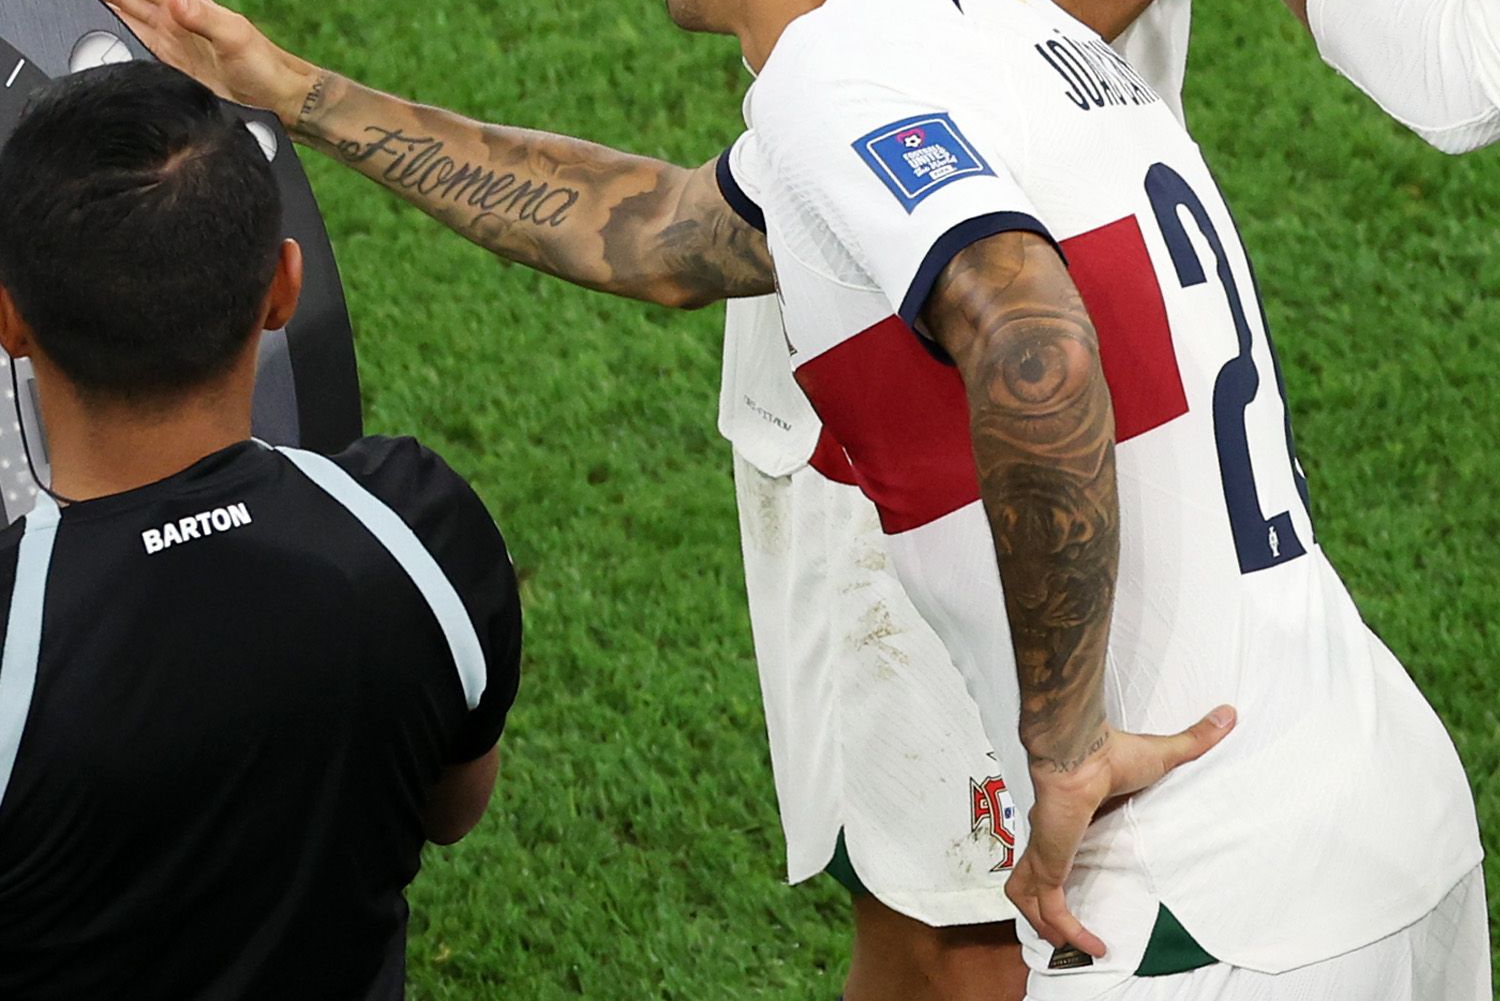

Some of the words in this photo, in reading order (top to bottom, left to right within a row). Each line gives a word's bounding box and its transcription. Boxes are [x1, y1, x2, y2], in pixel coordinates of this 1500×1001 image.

[336, 125, 579, 227] Filomena
[1144, 161, 1317, 575] 2
[141, 502, 252, 555] BARTON
